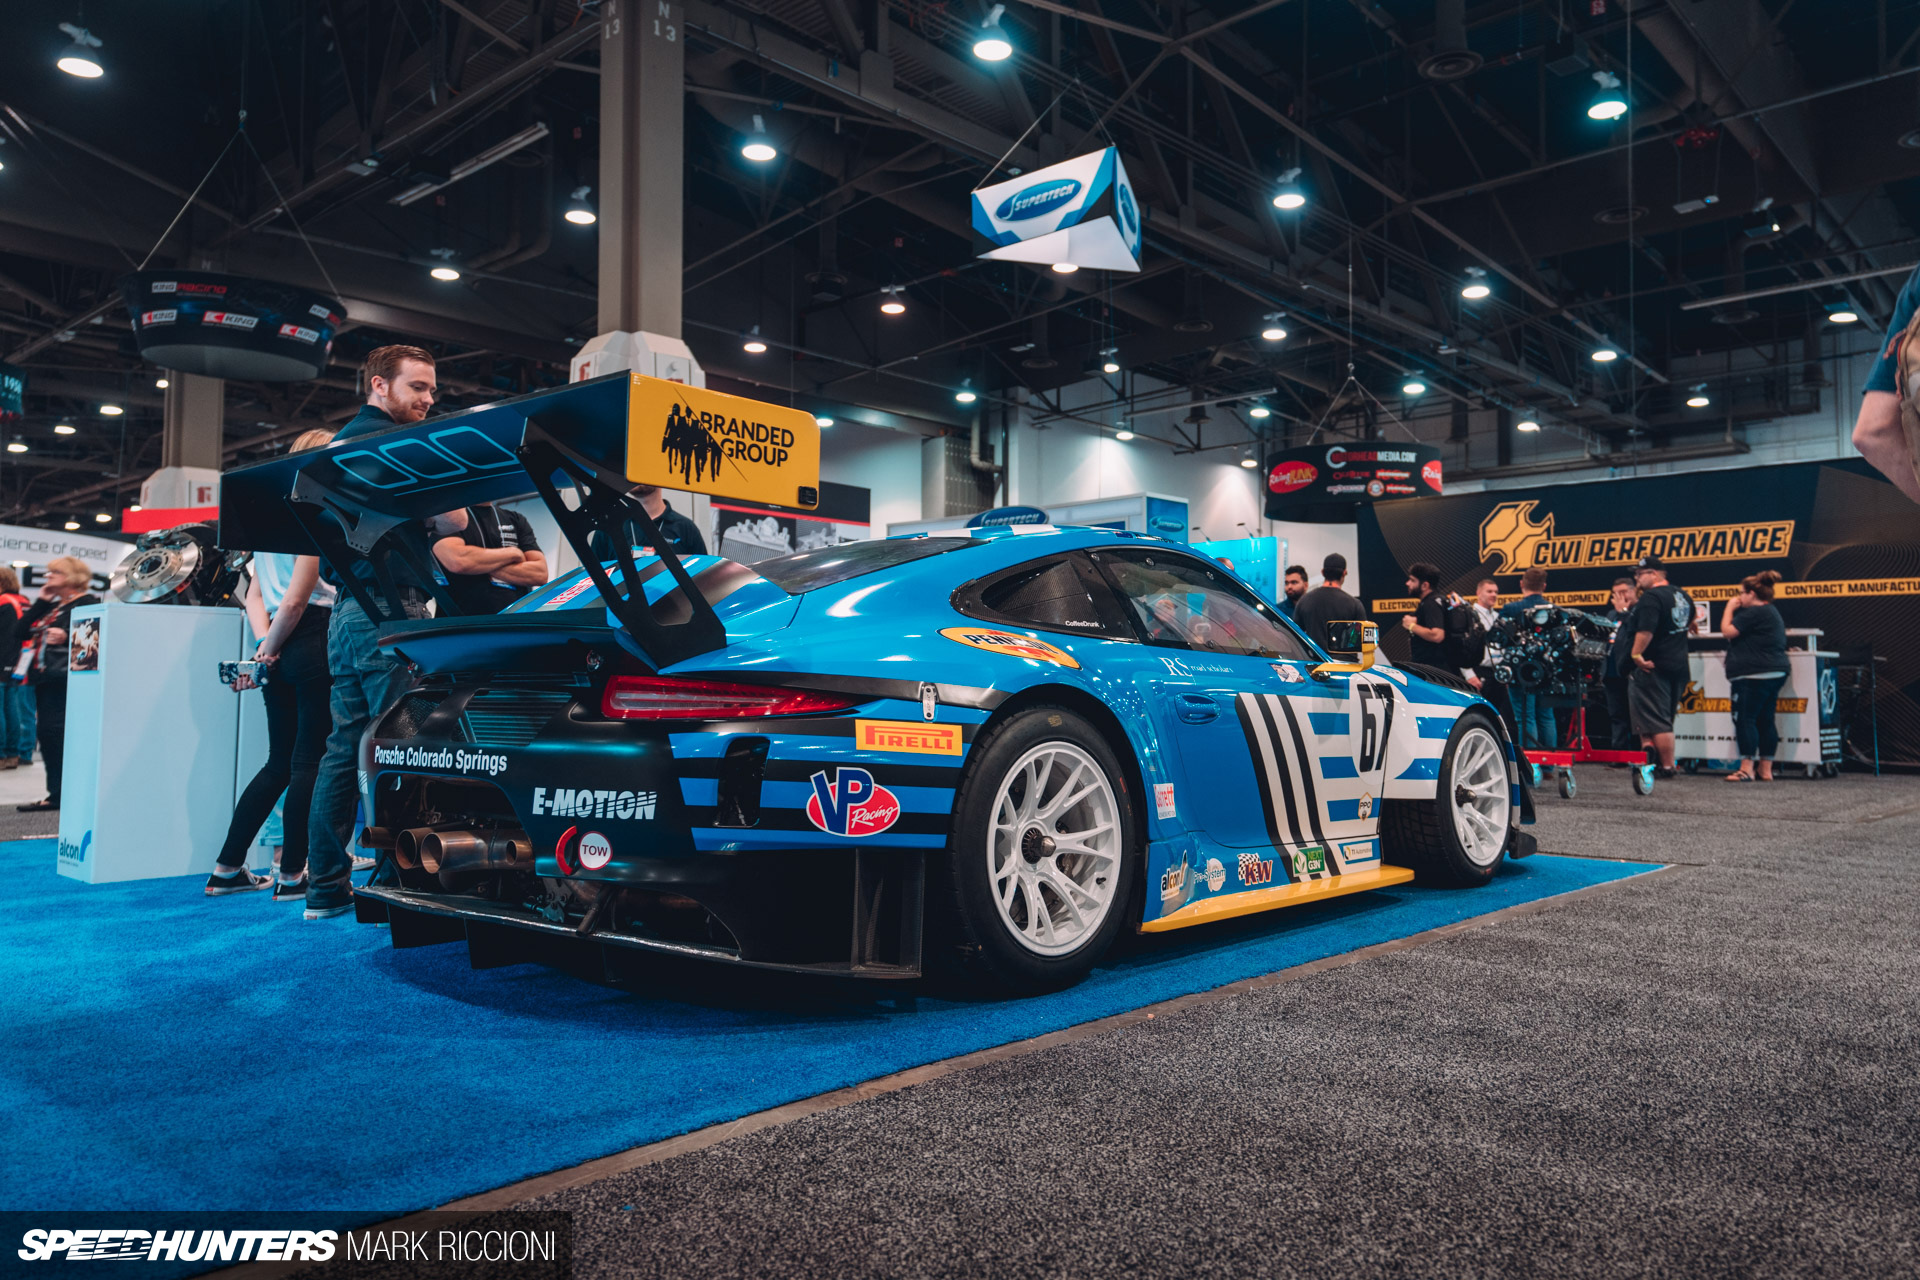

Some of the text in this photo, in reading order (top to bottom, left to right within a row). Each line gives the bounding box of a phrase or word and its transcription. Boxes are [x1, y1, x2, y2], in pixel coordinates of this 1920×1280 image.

[659, 1, 670, 19] N
[654, 19, 676, 42] 13
[1014, 183, 1076, 211] SUPERTECH
[225, 315, 257, 328] KING
[700, 411, 795, 448] BRANDED
[721, 438, 788, 467] GROUP
[53, 542, 68, 555] of
[71, 545, 108, 561] speed
[1533, 526, 1788, 566] CWI PERFORMANCE
[1544, 593, 1605, 604] EVELOPMENT
[1692, 588, 1742, 598] SOLUTION
[1785, 581, 1920, 595] CONTRACT MANUFACTU
[1380, 601, 1420, 611] ELECTRON
[1065, 620, 1100, 628] CoffeeDrunk
[1158, 657, 1193, 677] RS
[865, 725, 954, 750] PIRELLI
[1357, 683, 1395, 773] 67
[374, 745, 508, 777] Porsche Colorado Springs
[532, 786, 658, 820] E-MOTION
[810, 767, 875, 836] VP
[851, 806, 899, 829] Racing
[60, 837, 79, 861] alcon
[582, 844, 608, 857] TOW
[1307, 848, 1323, 861] NEXT
[1161, 868, 1181, 892] alcon
[1194, 868, 1226, 884] Pro-System
[1245, 860, 1273, 886] KW
